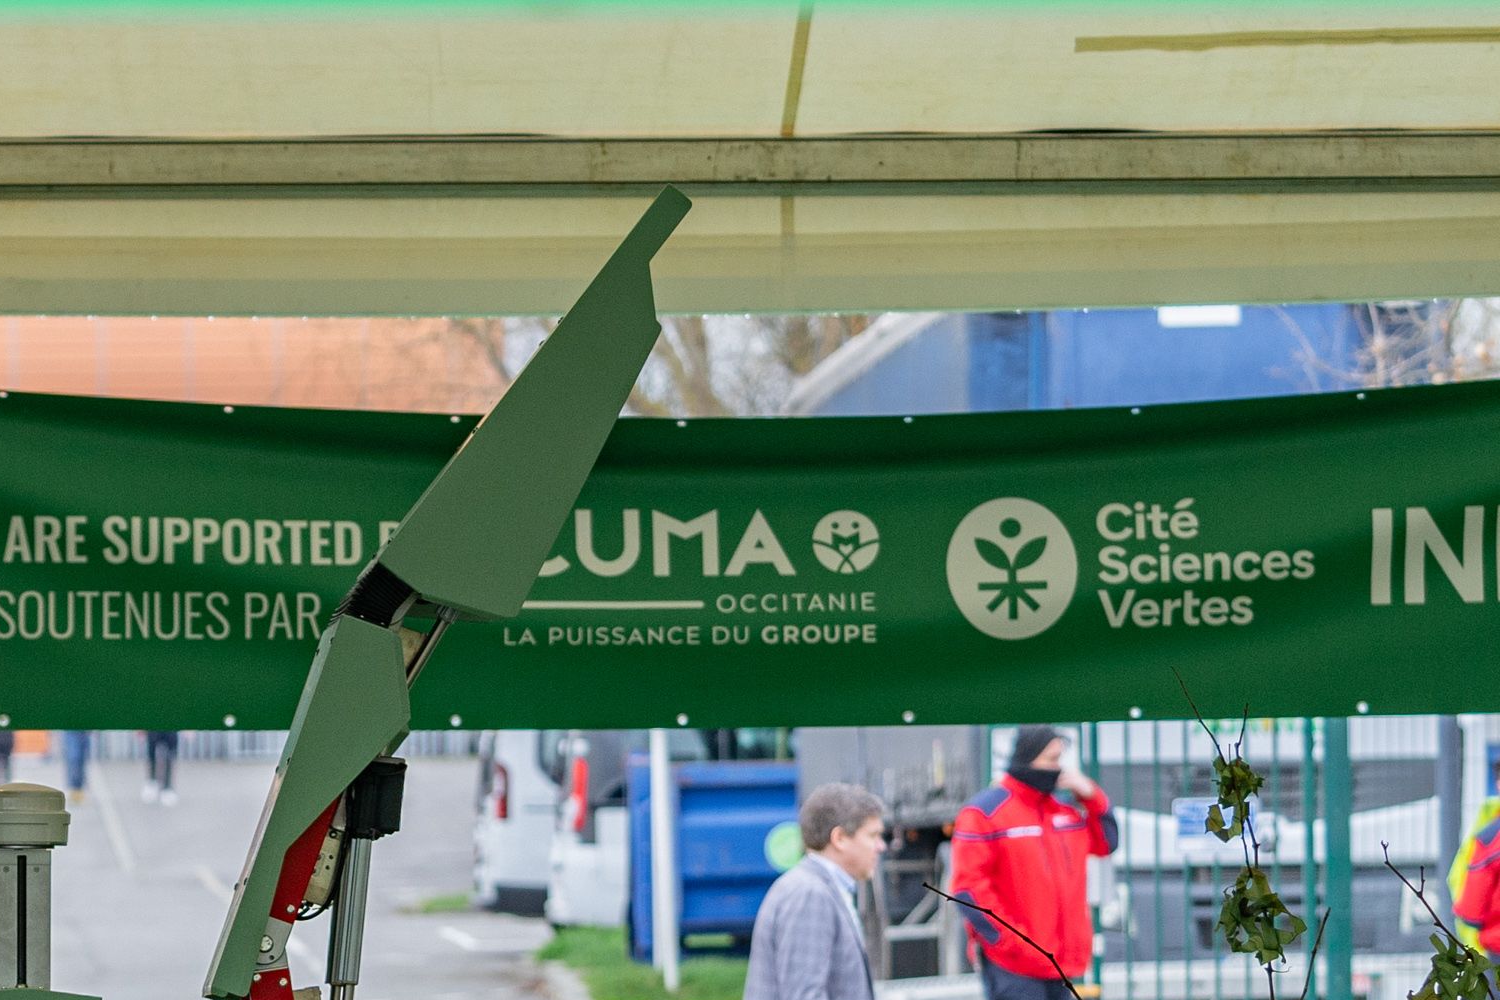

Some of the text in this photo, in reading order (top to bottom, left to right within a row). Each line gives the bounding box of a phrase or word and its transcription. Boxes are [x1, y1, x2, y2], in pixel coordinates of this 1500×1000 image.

[3, 515, 88, 564] ARE
[102, 516, 362, 566] SUPPORTED
[1096, 497, 1199, 541] Cité
[538, 508, 798, 577] UMA
[1097, 543, 1315, 584] Sciences
[1370, 505, 1500, 606] IN
[244, 592, 321, 640] PAR
[716, 591, 876, 614] OCCITANIE
[1097, 588, 1254, 628] Vertes
[503, 624, 877, 646] LA PUISSANCE DU GROUPE
